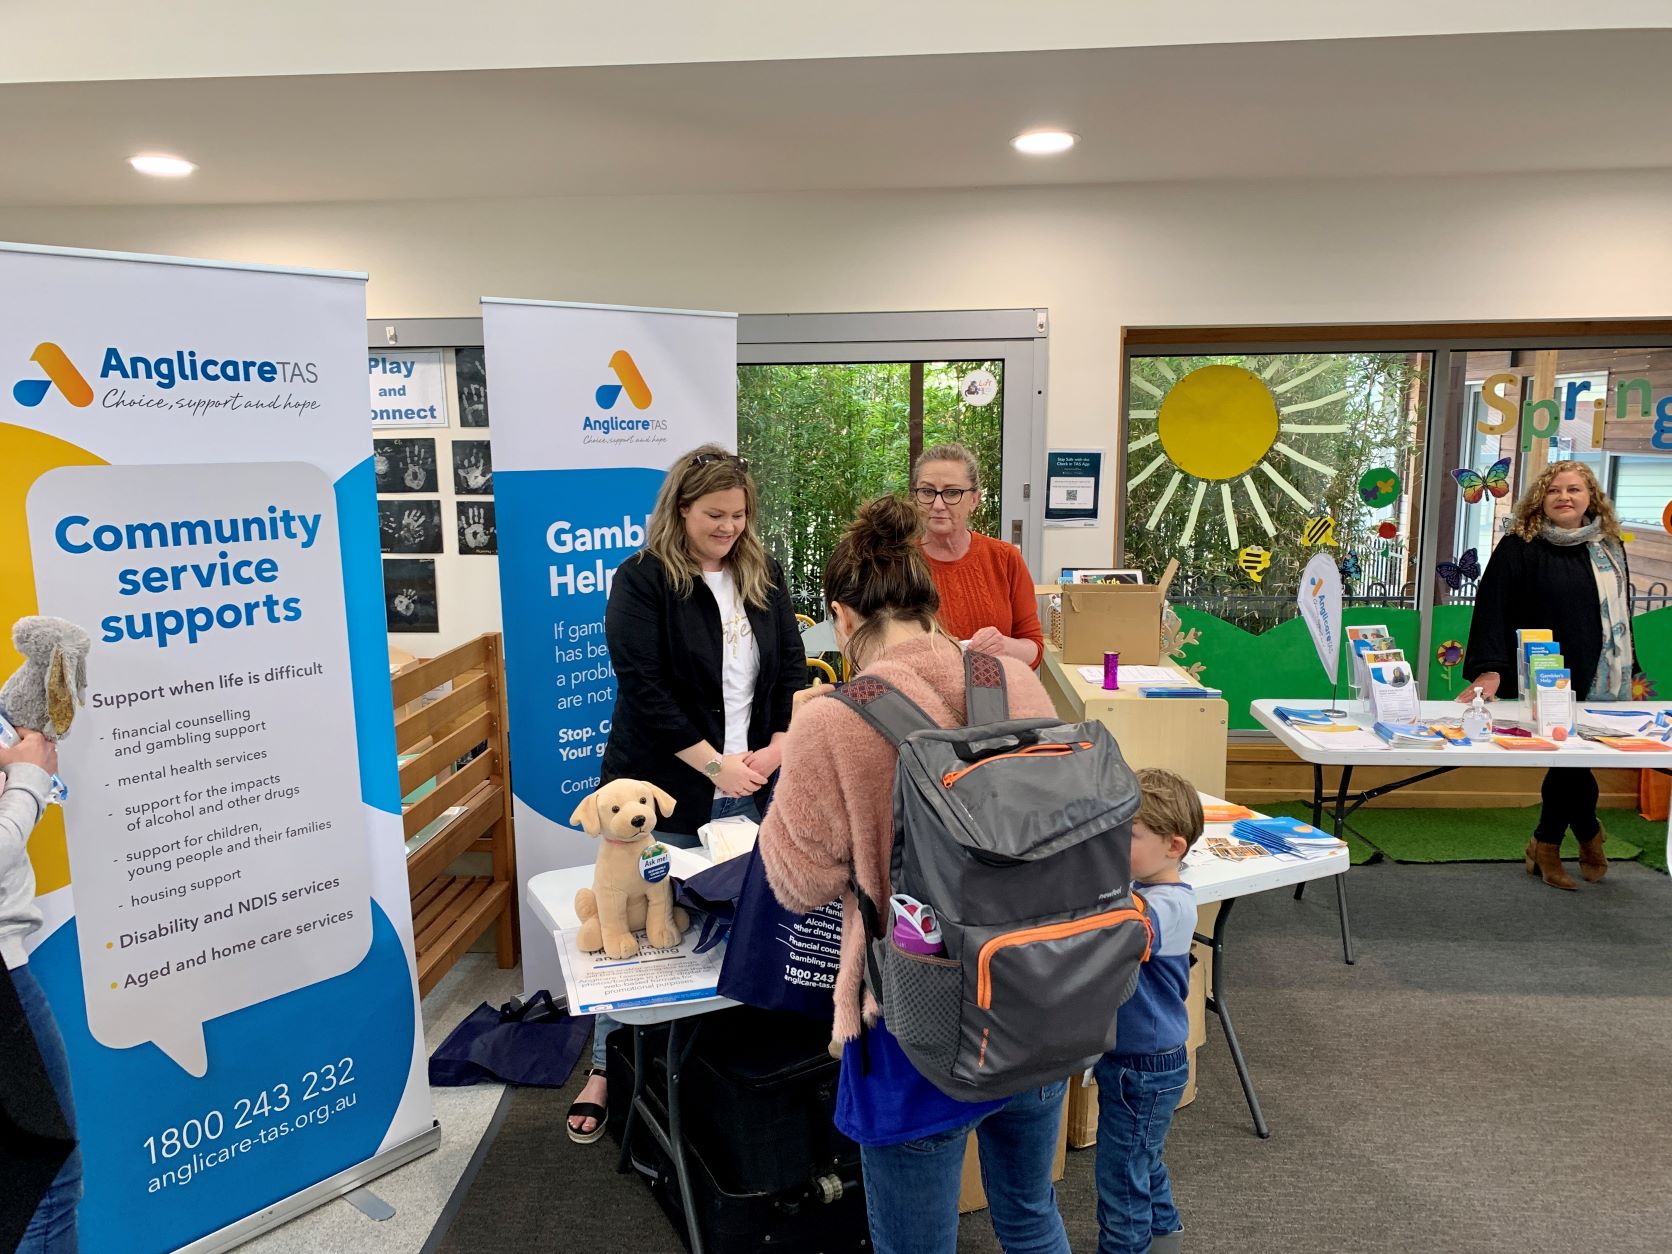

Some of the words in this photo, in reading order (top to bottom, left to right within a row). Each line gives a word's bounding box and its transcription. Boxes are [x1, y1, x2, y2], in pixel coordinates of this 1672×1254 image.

[368, 357, 416, 378] Play
[102, 388, 174, 411] Choice,
[176, 394, 242, 417] support
[243, 393, 283, 411] and
[283, 393, 321, 417] hope
[378, 384, 407, 397] and
[371, 404, 437, 421] onnect
[1477, 373, 1672, 453] Spring
[55, 505, 322, 555] Community
[118, 550, 279, 596] service
[101, 594, 303, 648] supports
[554, 620, 565, 640] If
[555, 645, 583, 663] has
[587, 641, 609, 659] be
[92, 685, 165, 709] Support
[169, 680, 215, 697] when
[219, 673, 244, 689] life
[248, 671, 260, 684] is
[264, 662, 324, 682] difficult
[556, 674, 566, 687] a
[557, 695, 583, 710] are
[587, 686, 613, 704] not
[112, 720, 171, 741] financial
[175, 708, 251, 730] counselling
[114, 741, 142, 757] and
[146, 730, 211, 755] gambling
[215, 720, 267, 740] support
[559, 722, 596, 743] Stop.
[599, 719, 612, 736] C
[558, 745, 593, 762] Your
[595, 741, 608, 758] g
[118, 767, 166, 787] mental
[170, 760, 212, 776] health
[216, 749, 268, 768] services
[125, 795, 181, 817] support
[184, 790, 203, 803] for
[206, 784, 228, 798] the
[231, 773, 281, 795] impacts
[561, 776, 600, 795] Conta
[127, 819, 142, 832] of
[145, 806, 195, 827] alcohol
[199, 801, 224, 815] and
[227, 793, 261, 810] other
[264, 784, 300, 804] drugs
[126, 840, 181, 865] support
[184, 835, 203, 848] for
[206, 822, 262, 844] children,
[127, 858, 172, 881] young
[176, 845, 223, 869] people
[227, 838, 251, 853] and
[254, 830, 283, 847] their
[285, 819, 332, 839] families
[644, 858, 656, 867] Ask
[131, 884, 187, 908] housing
[190, 869, 242, 892] support
[119, 916, 199, 949] Disability
[203, 904, 234, 924] and
[238, 892, 278, 915] NDIS
[281, 876, 340, 903] services
[805, 918, 834, 930] Alcohol
[789, 935, 820, 951] Financial
[793, 923, 812, 934] other
[813, 927, 831, 939] drug
[124, 961, 171, 989] Aged
[175, 951, 207, 973] and
[211, 937, 257, 962] home
[260, 926, 292, 946] care
[296, 908, 354, 935] services
[789, 951, 826, 968] Gambling
[827, 961, 840, 970] sup
[784, 974, 837, 989] anglicare-tas.o
[785, 964, 811, 980] 1800
[812, 972, 834, 983] 243
[142, 1109, 224, 1166] 1800
[233, 1083, 290, 1130] 243
[302, 1056, 355, 1102] 232
[148, 1093, 357, 1194] anglicare-tas.org.au
